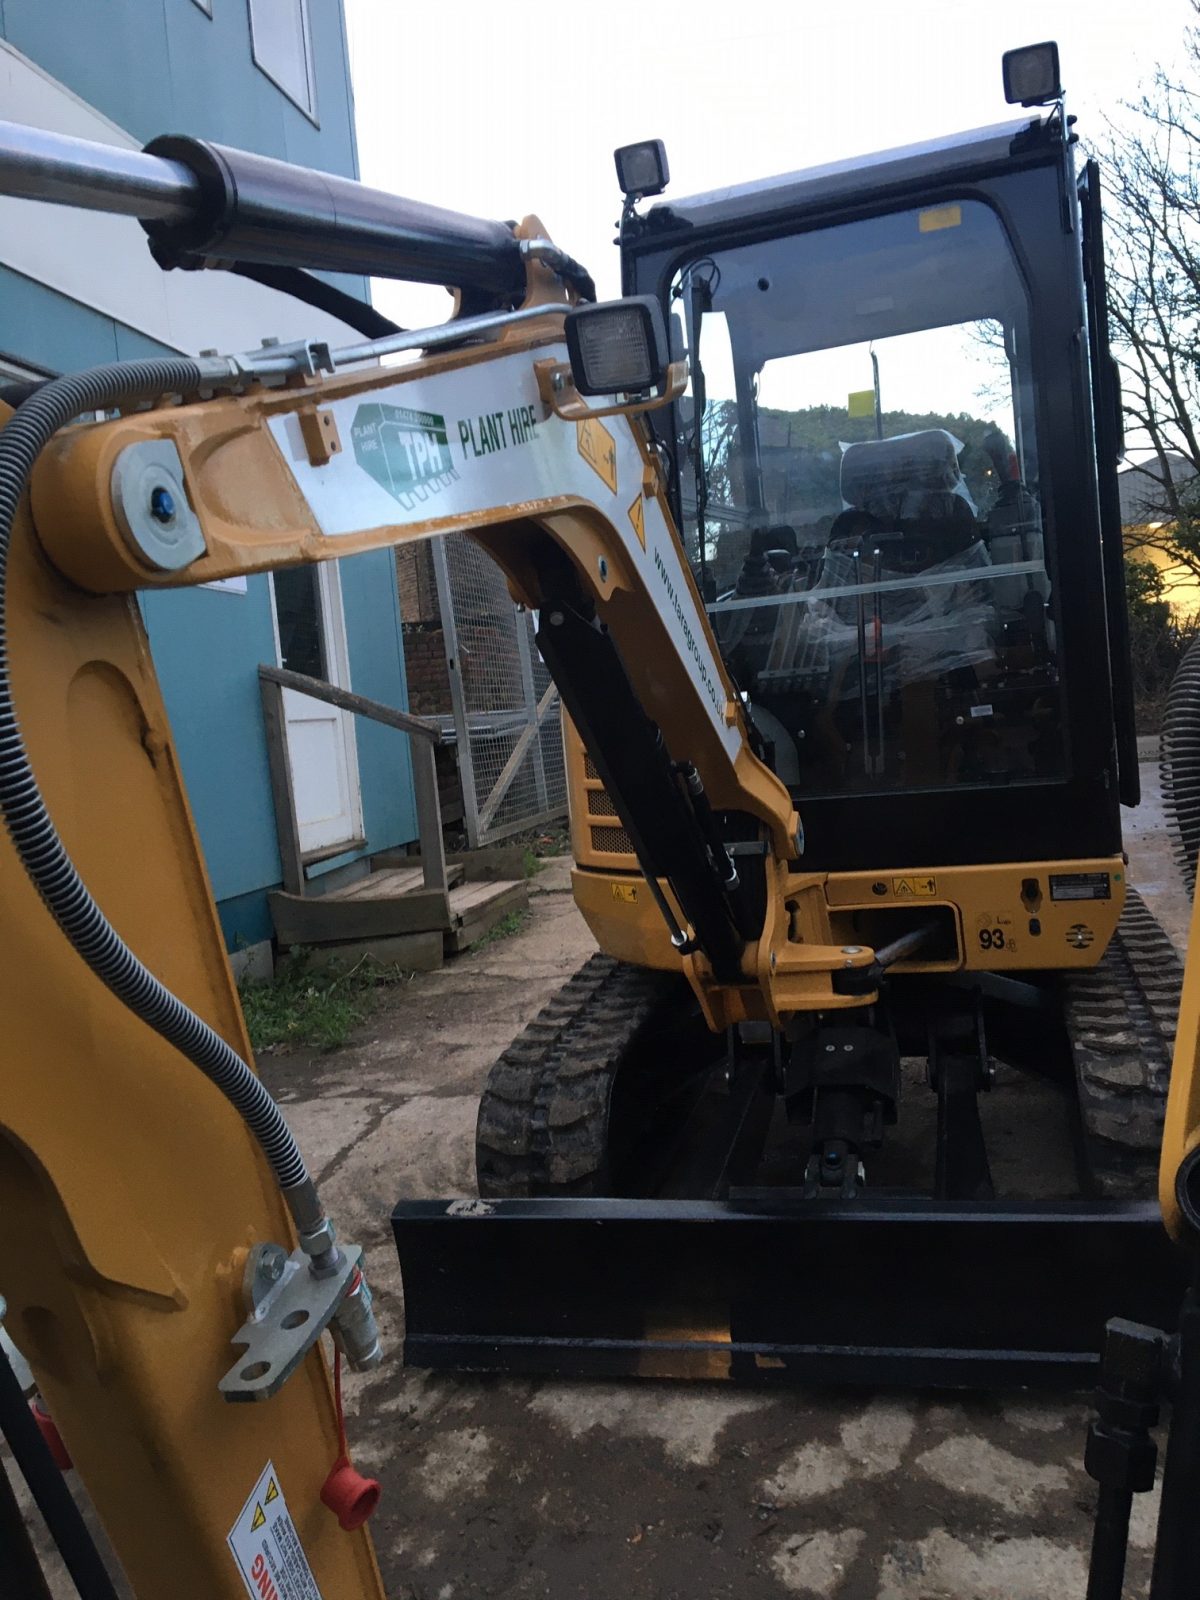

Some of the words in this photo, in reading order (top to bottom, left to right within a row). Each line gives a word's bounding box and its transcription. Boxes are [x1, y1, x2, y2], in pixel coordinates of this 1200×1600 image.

[353, 422, 376, 438] PLANT
[457, 411, 507, 460] PLANT
[507, 404, 539, 446] HIRE
[398, 431, 443, 481] TPH
[654, 547, 724, 725] www.taragroup.co.uk
[979, 928, 1005, 950] 93
